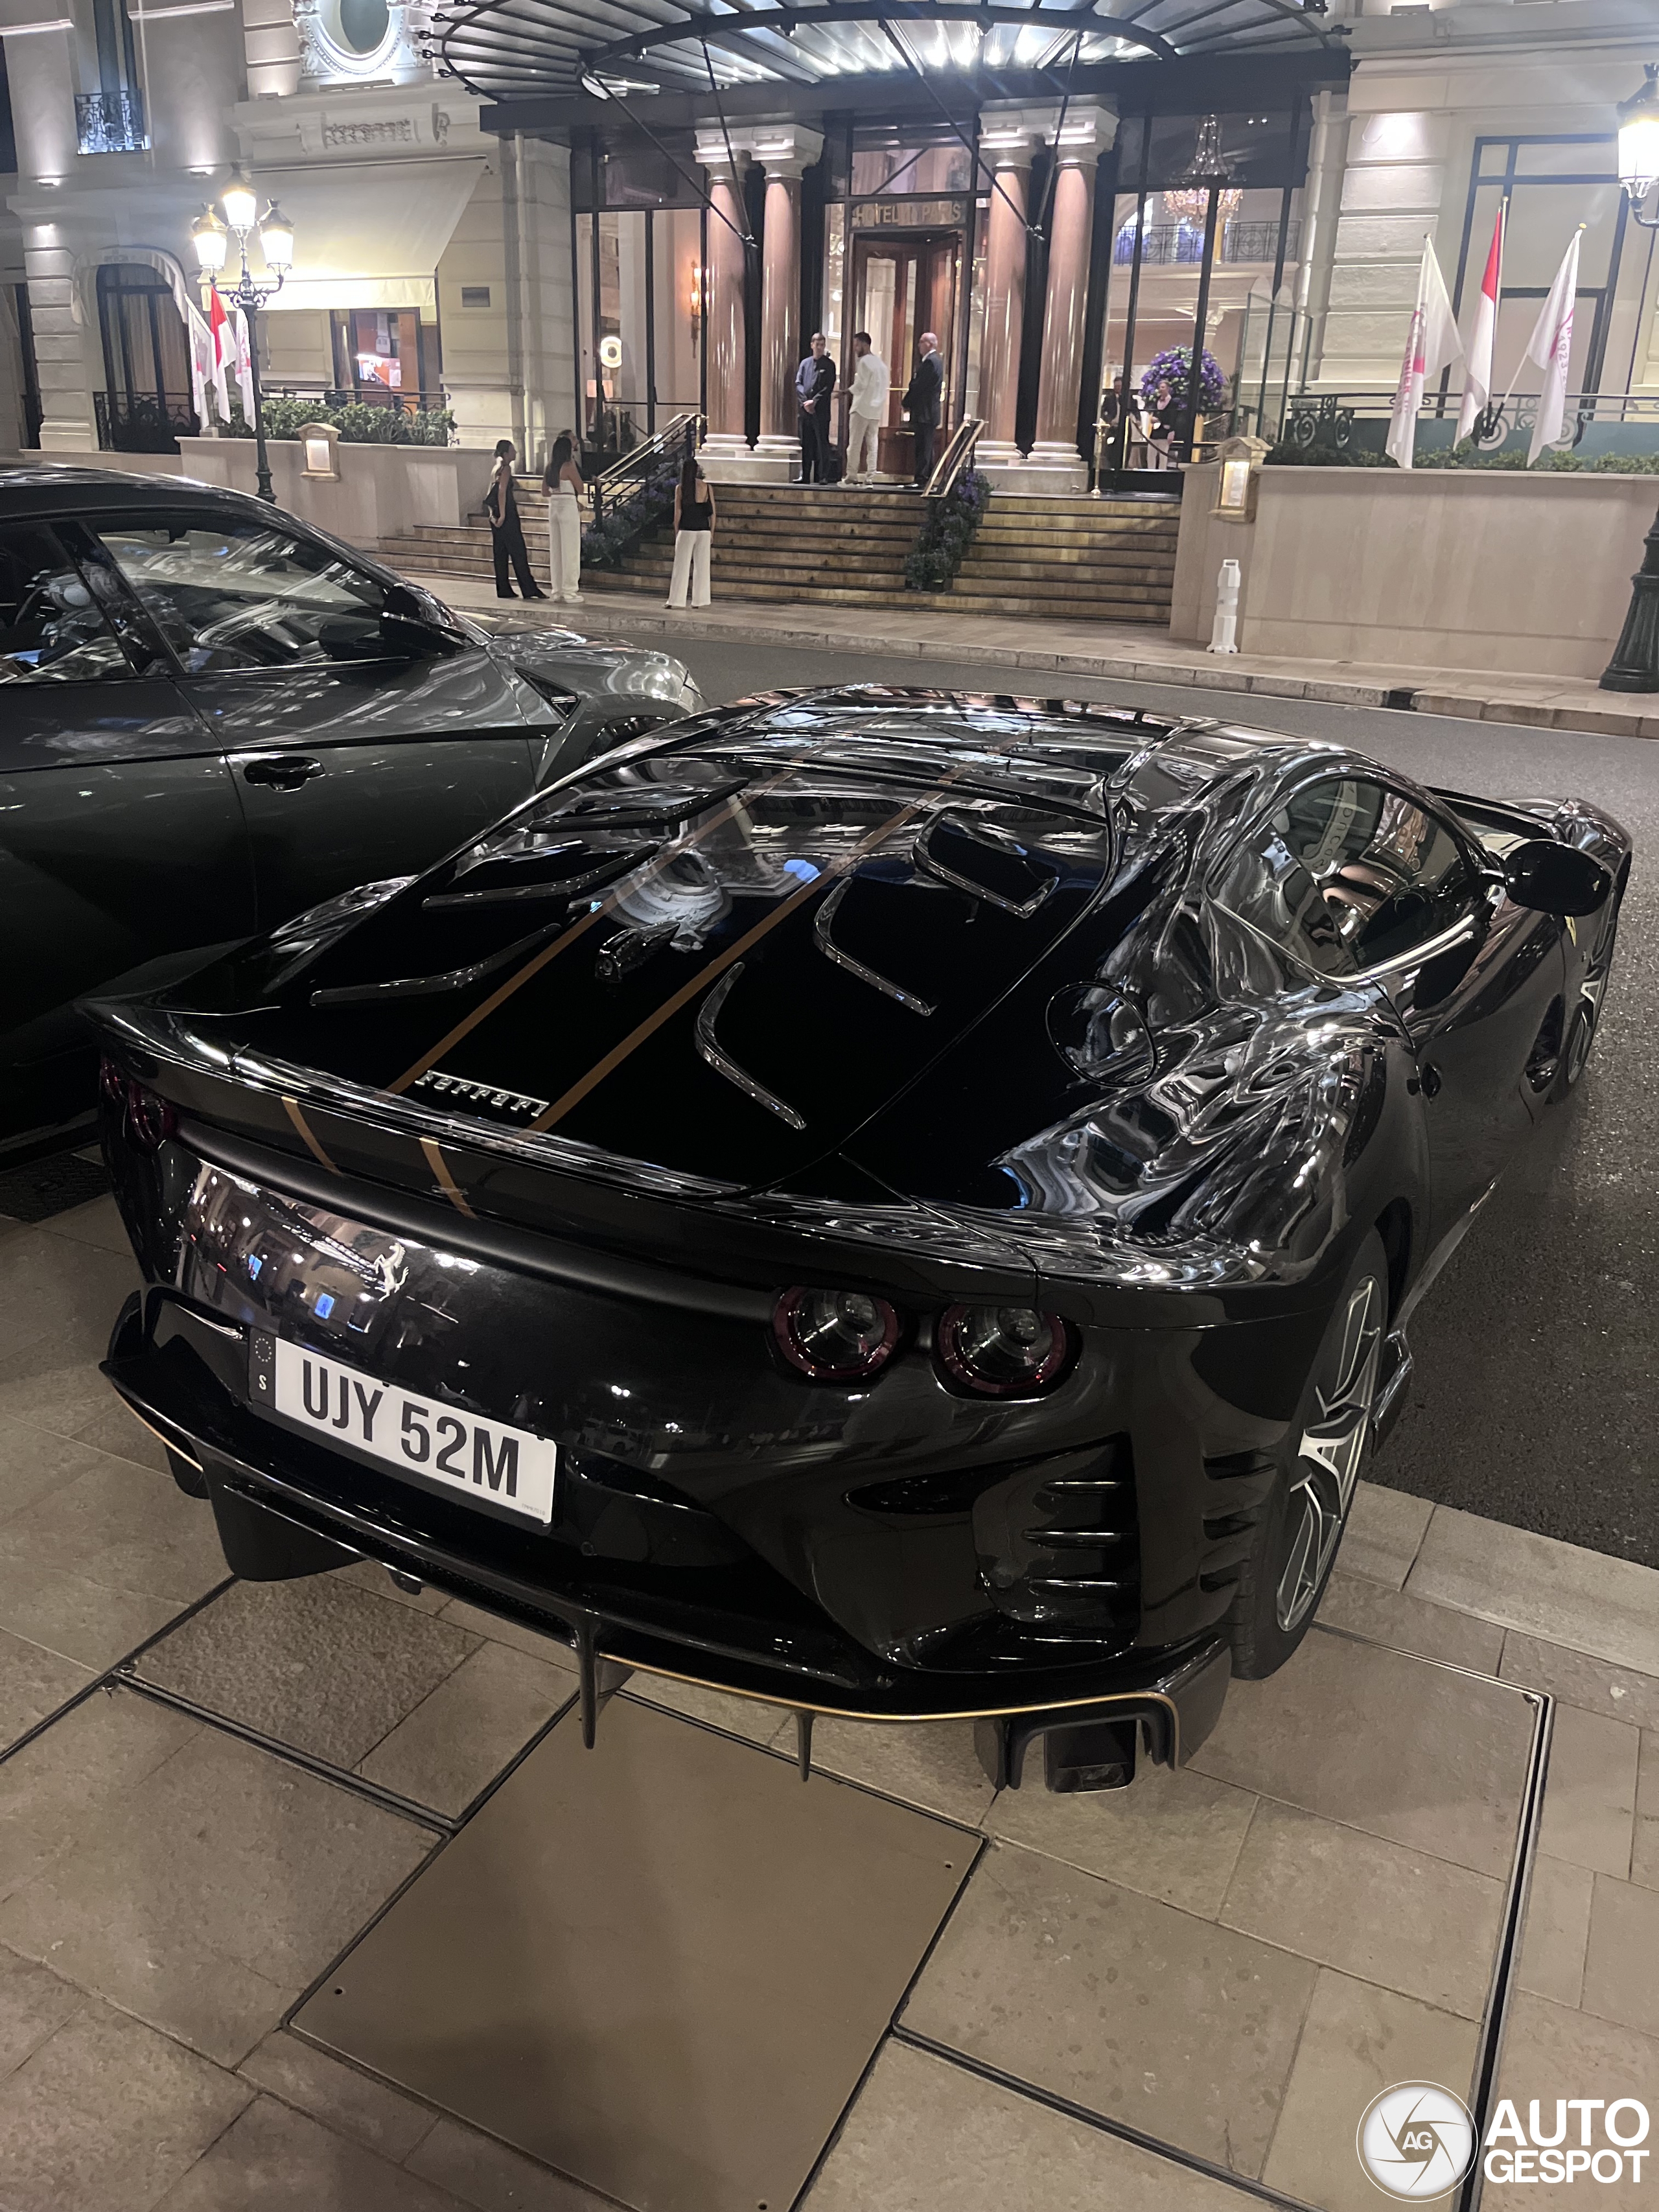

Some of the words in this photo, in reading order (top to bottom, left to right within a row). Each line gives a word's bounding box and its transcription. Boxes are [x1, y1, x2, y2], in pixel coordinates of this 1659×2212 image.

[414, 1069, 550, 1117] Ferrari
[259, 1374, 267, 1390] S
[303, 1358, 383, 1442] UJY
[400, 1400, 519, 1497] 52M
